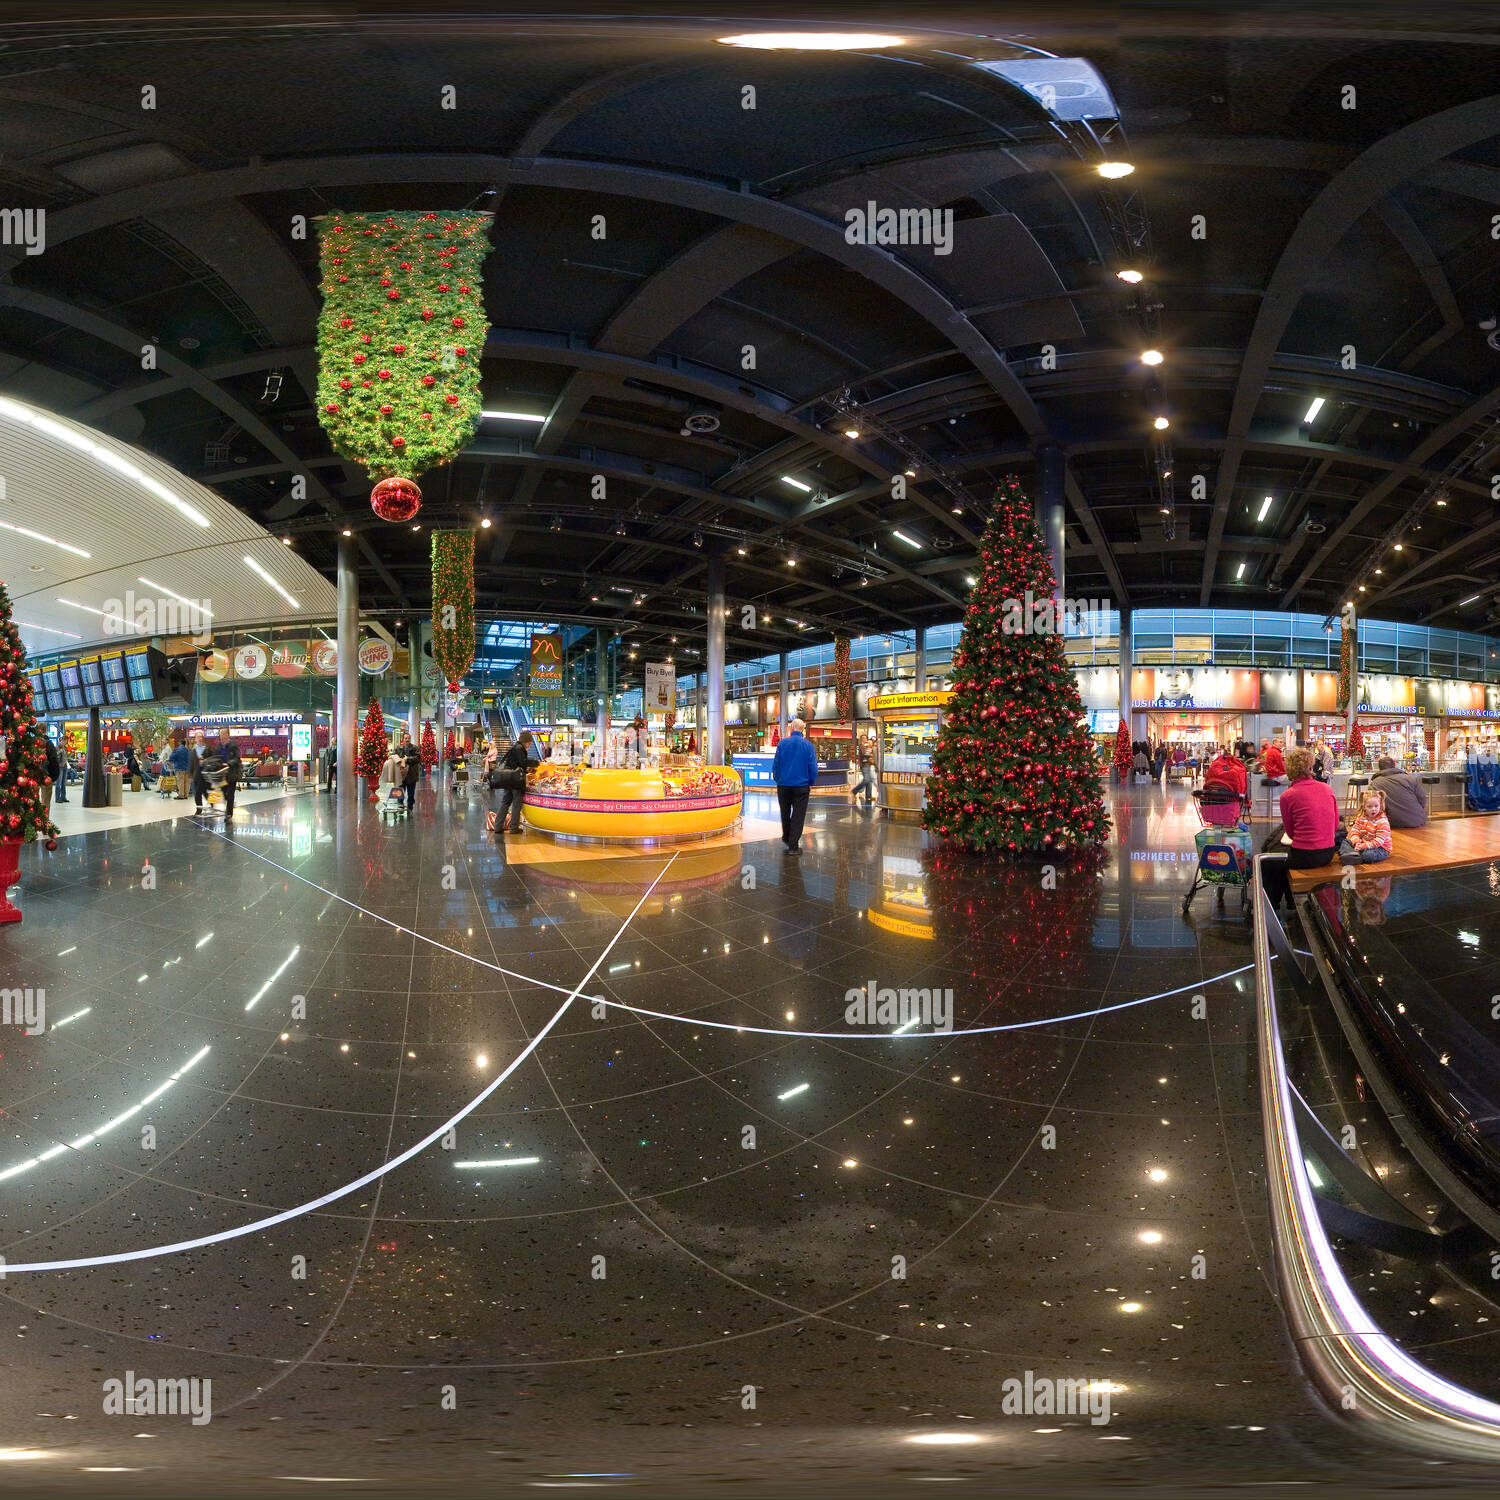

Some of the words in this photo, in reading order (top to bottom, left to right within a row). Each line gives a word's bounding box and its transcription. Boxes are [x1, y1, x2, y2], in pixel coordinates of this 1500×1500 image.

[360, 645, 387, 657] BURGER
[361, 651, 389, 666] KING
[646, 667, 659, 677] Buy
[876, 697, 896, 706] Airport
[897, 694, 939, 703] Information
[1394, 705, 1417, 714] GIFTS
[1447, 707, 1475, 717] WHISKY
[188, 714, 263, 723] communication
[268, 714, 303, 722] centre
[294, 731, 310, 747] 155
[569, 801, 578, 809] Say
